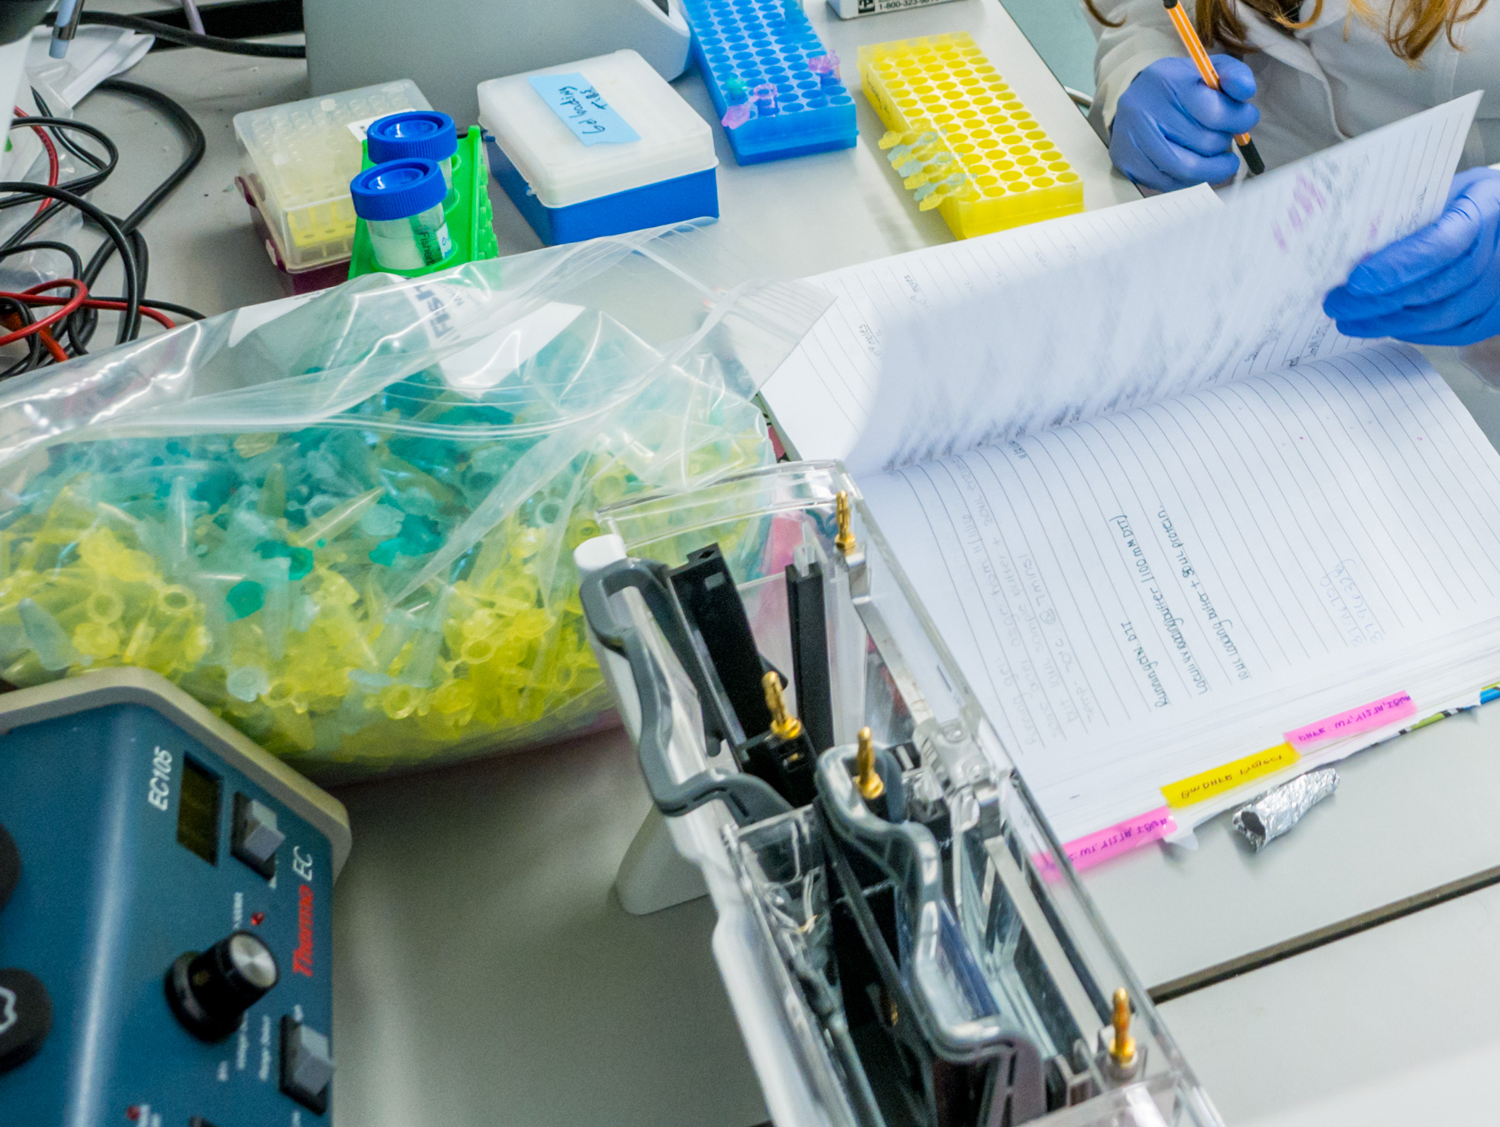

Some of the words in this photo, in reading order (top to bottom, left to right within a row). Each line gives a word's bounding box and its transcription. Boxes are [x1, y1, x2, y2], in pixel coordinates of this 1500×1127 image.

[148, 746, 173, 811] EC105
[292, 846, 313, 881] EC
[292, 884, 314, 977] Thermo
